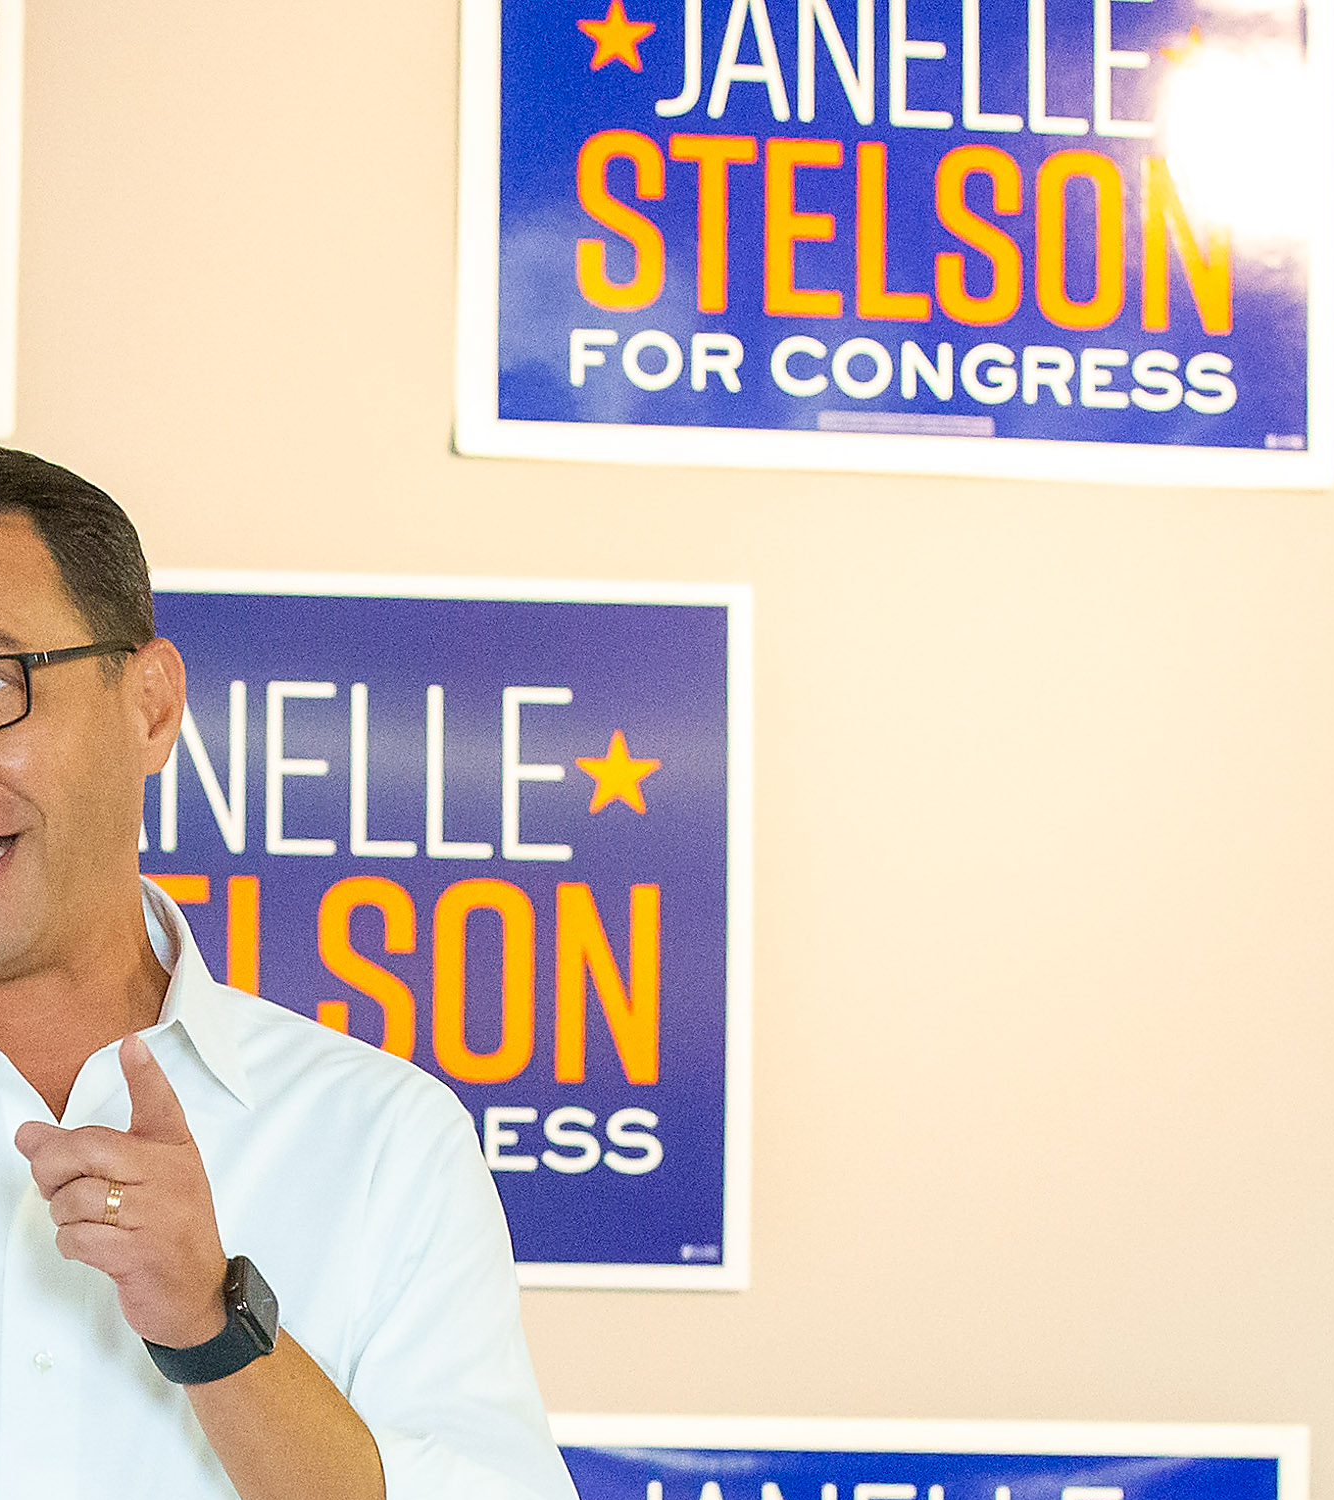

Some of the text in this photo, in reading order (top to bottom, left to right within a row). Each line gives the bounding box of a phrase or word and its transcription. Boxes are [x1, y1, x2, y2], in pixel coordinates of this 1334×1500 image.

[654, 0, 1159, 138] JANELLE
[576, 129, 1234, 336] STELSON
[568, 328, 1238, 416] FOR CONGRESS
[139, 680, 573, 861] NELLE
